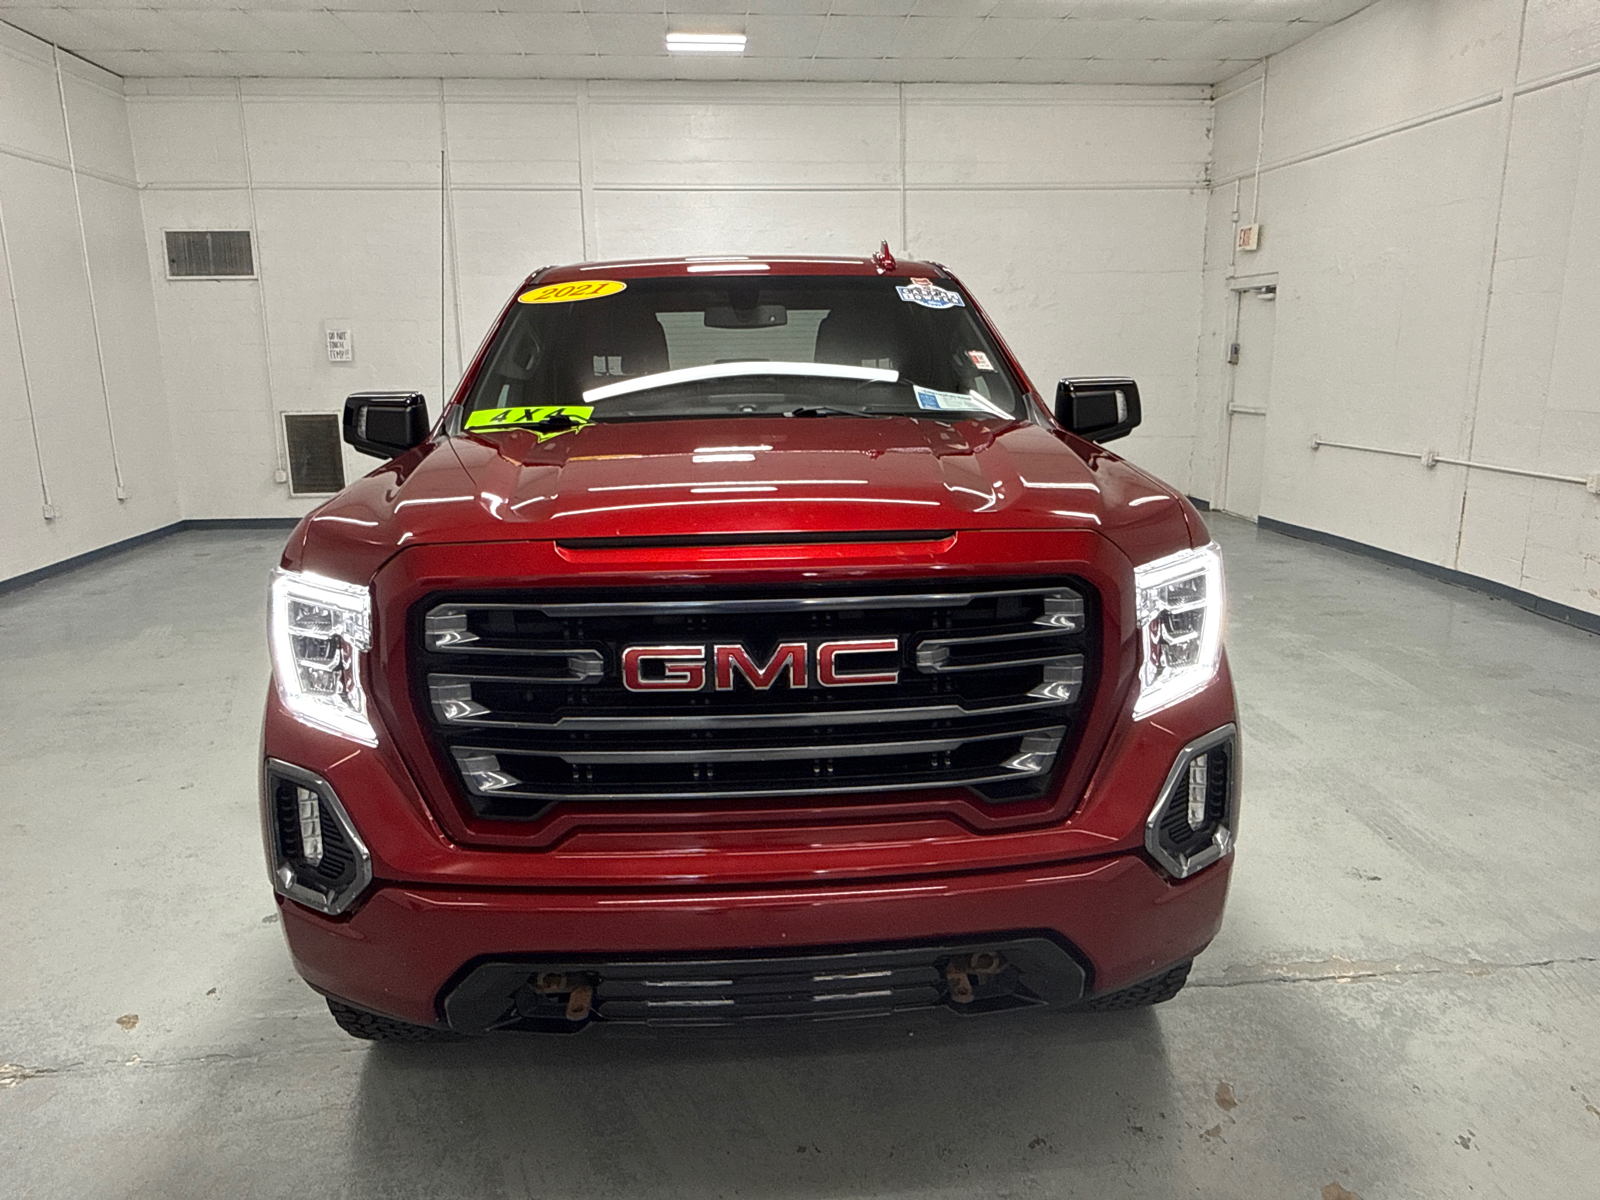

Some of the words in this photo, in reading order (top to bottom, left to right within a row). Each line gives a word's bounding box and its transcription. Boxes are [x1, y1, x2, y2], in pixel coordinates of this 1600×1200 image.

[533, 283, 610, 301] 2021
[336, 331, 347, 340] NOT
[622, 638, 899, 692] GMC
